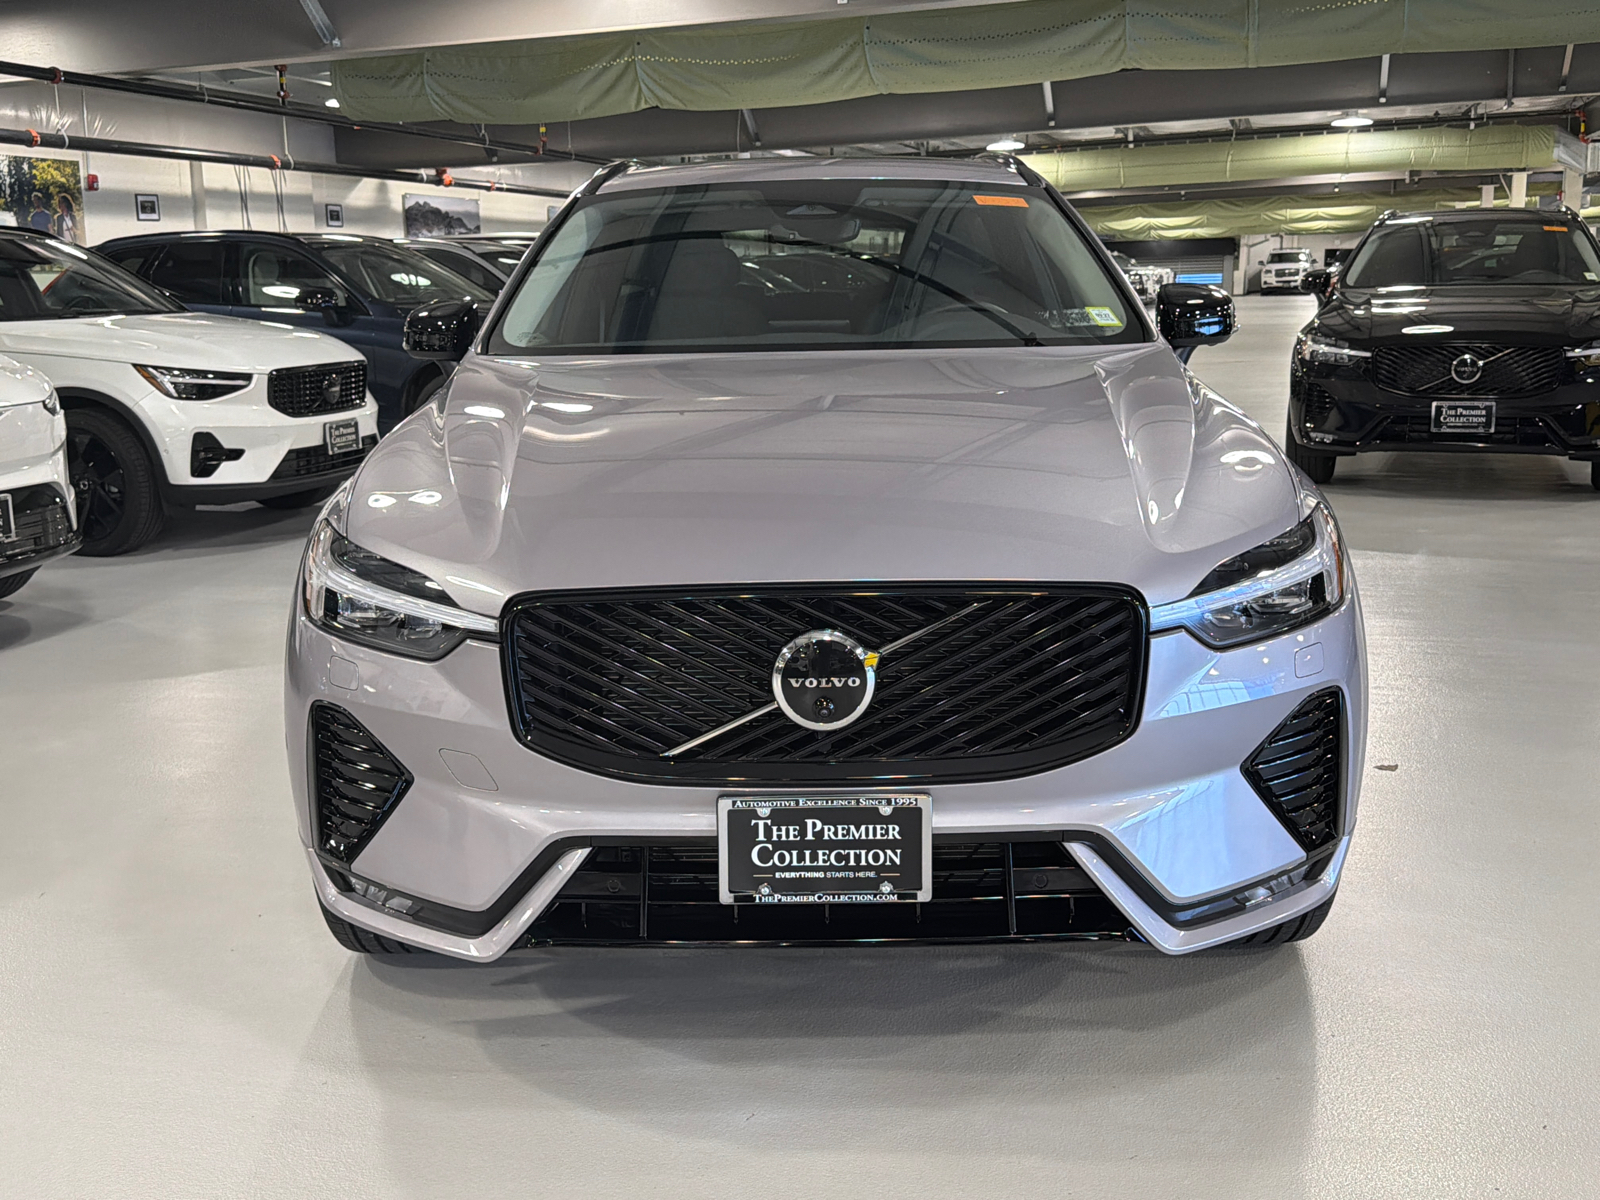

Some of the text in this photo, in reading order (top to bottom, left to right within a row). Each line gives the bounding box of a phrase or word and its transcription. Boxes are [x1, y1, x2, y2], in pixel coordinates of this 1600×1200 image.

[1457, 408, 1486, 416] PREMIER
[1440, 415, 1486, 423] COLLECTION
[787, 676, 861, 688] VOLVO
[734, 797, 917, 809] AUTOMOTIVE EXCELLENCE SINCE 1995
[751, 818, 902, 841] THE PREMIER
[751, 843, 902, 867] COLLECTION
[775, 871, 825, 879] EVERYTHING
[855, 870, 878, 878] HERE.
[753, 892, 898, 903] THEPREMIERCOLLECTION.COM
